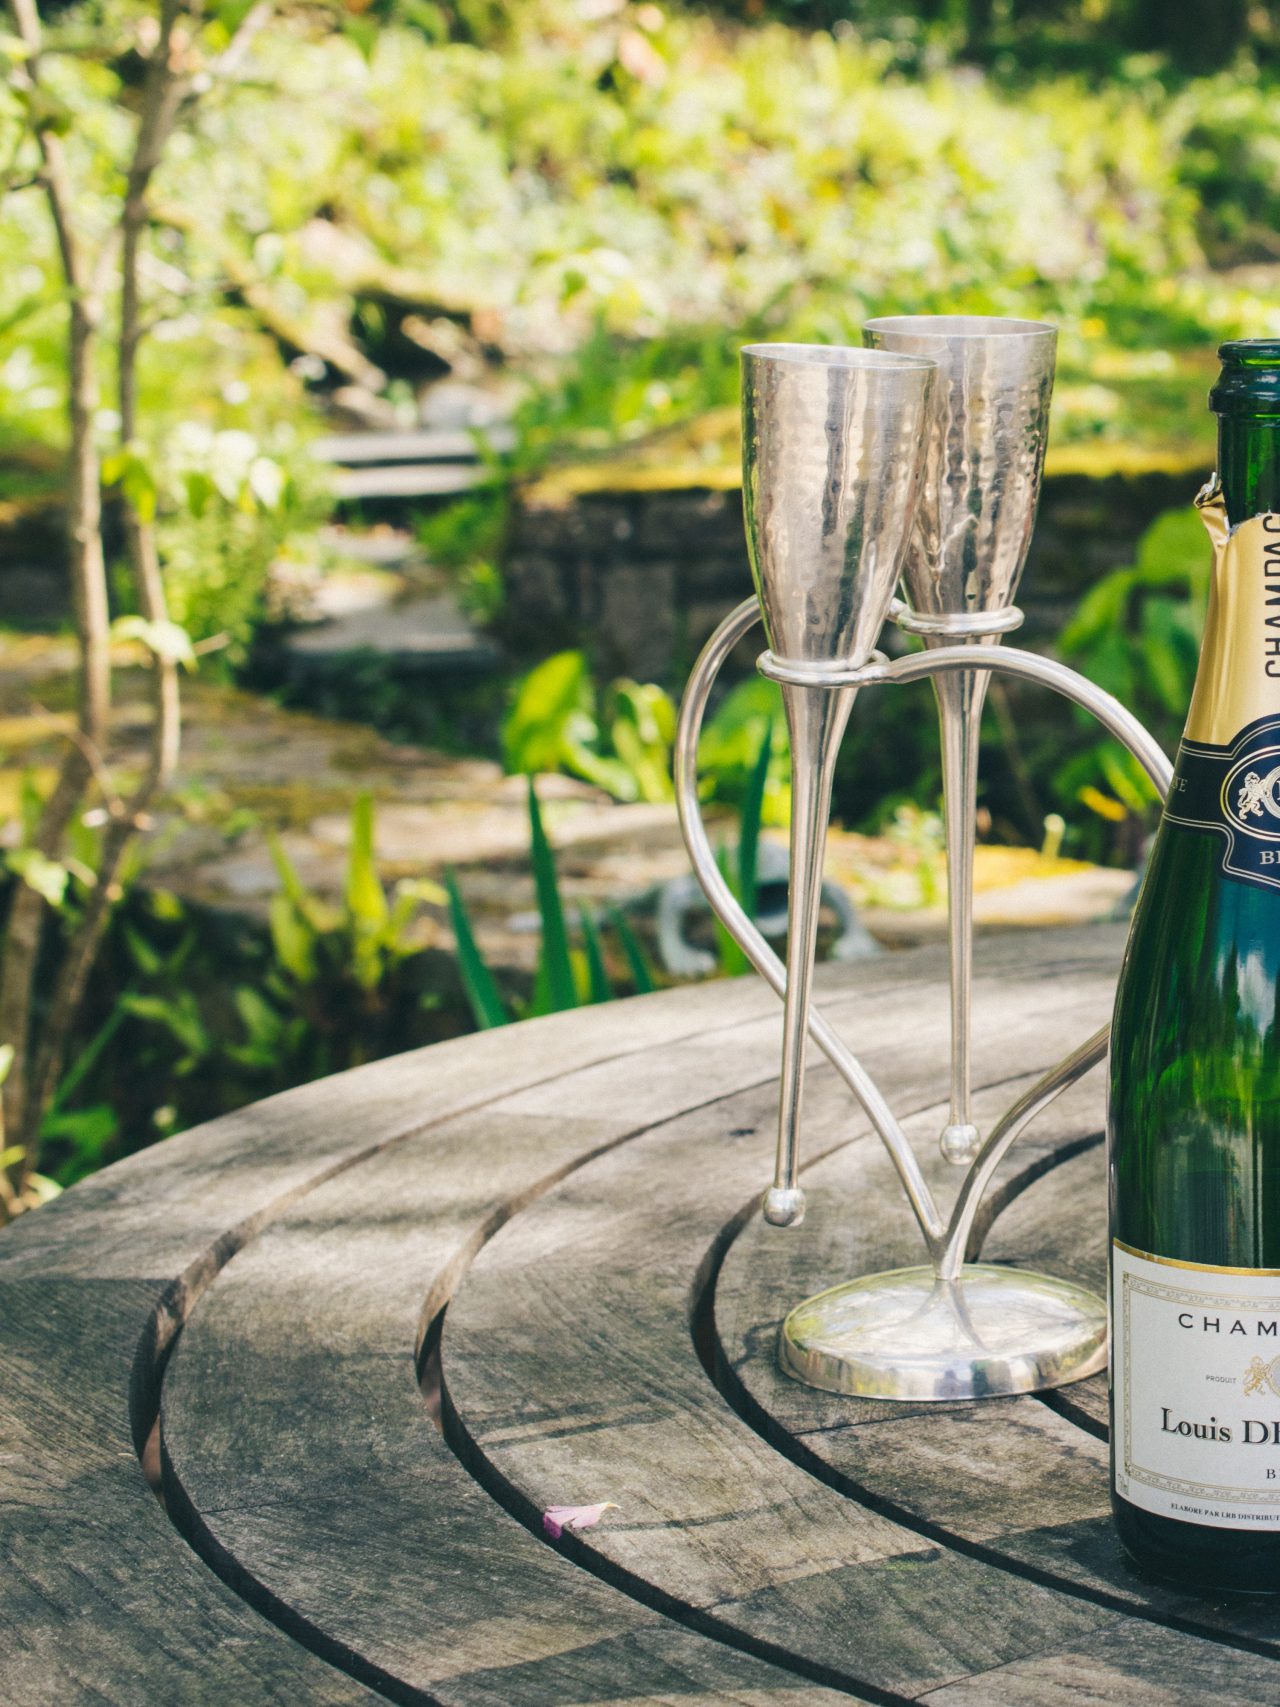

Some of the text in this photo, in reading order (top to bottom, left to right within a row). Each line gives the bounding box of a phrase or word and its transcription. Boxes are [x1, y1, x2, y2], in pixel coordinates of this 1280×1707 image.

[1205, 1374, 1238, 1385] PRODUIT
[1160, 1407, 1232, 1443] Louis
[1204, 1508, 1220, 1518] PAR
